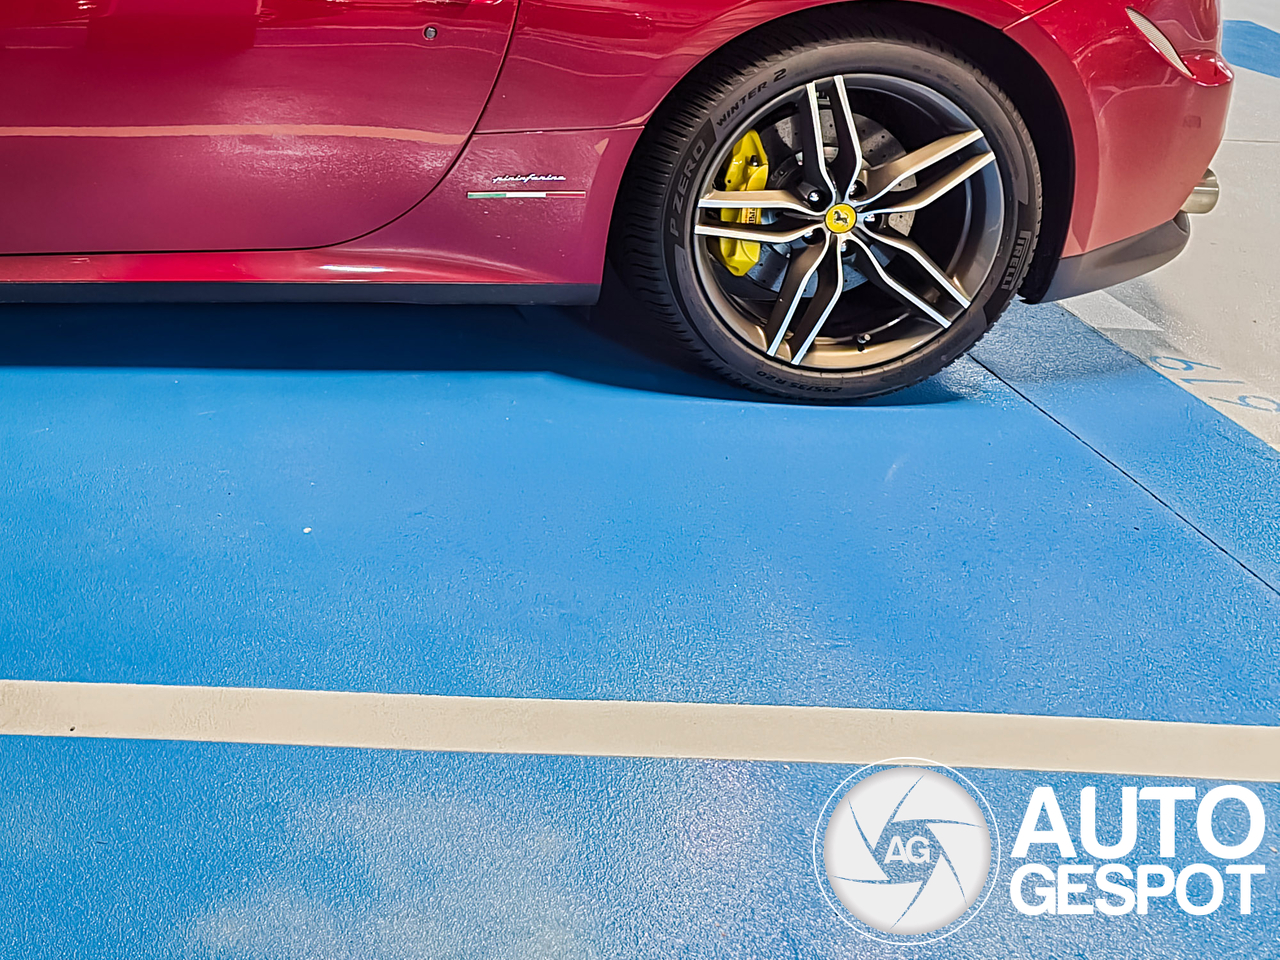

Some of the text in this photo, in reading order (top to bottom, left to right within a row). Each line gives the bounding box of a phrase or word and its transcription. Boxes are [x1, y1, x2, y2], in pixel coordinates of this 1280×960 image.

[716, 80, 768, 127] WINTER
[773, 68, 787, 83] 2
[1000, 230, 1033, 291] PIRELLI
